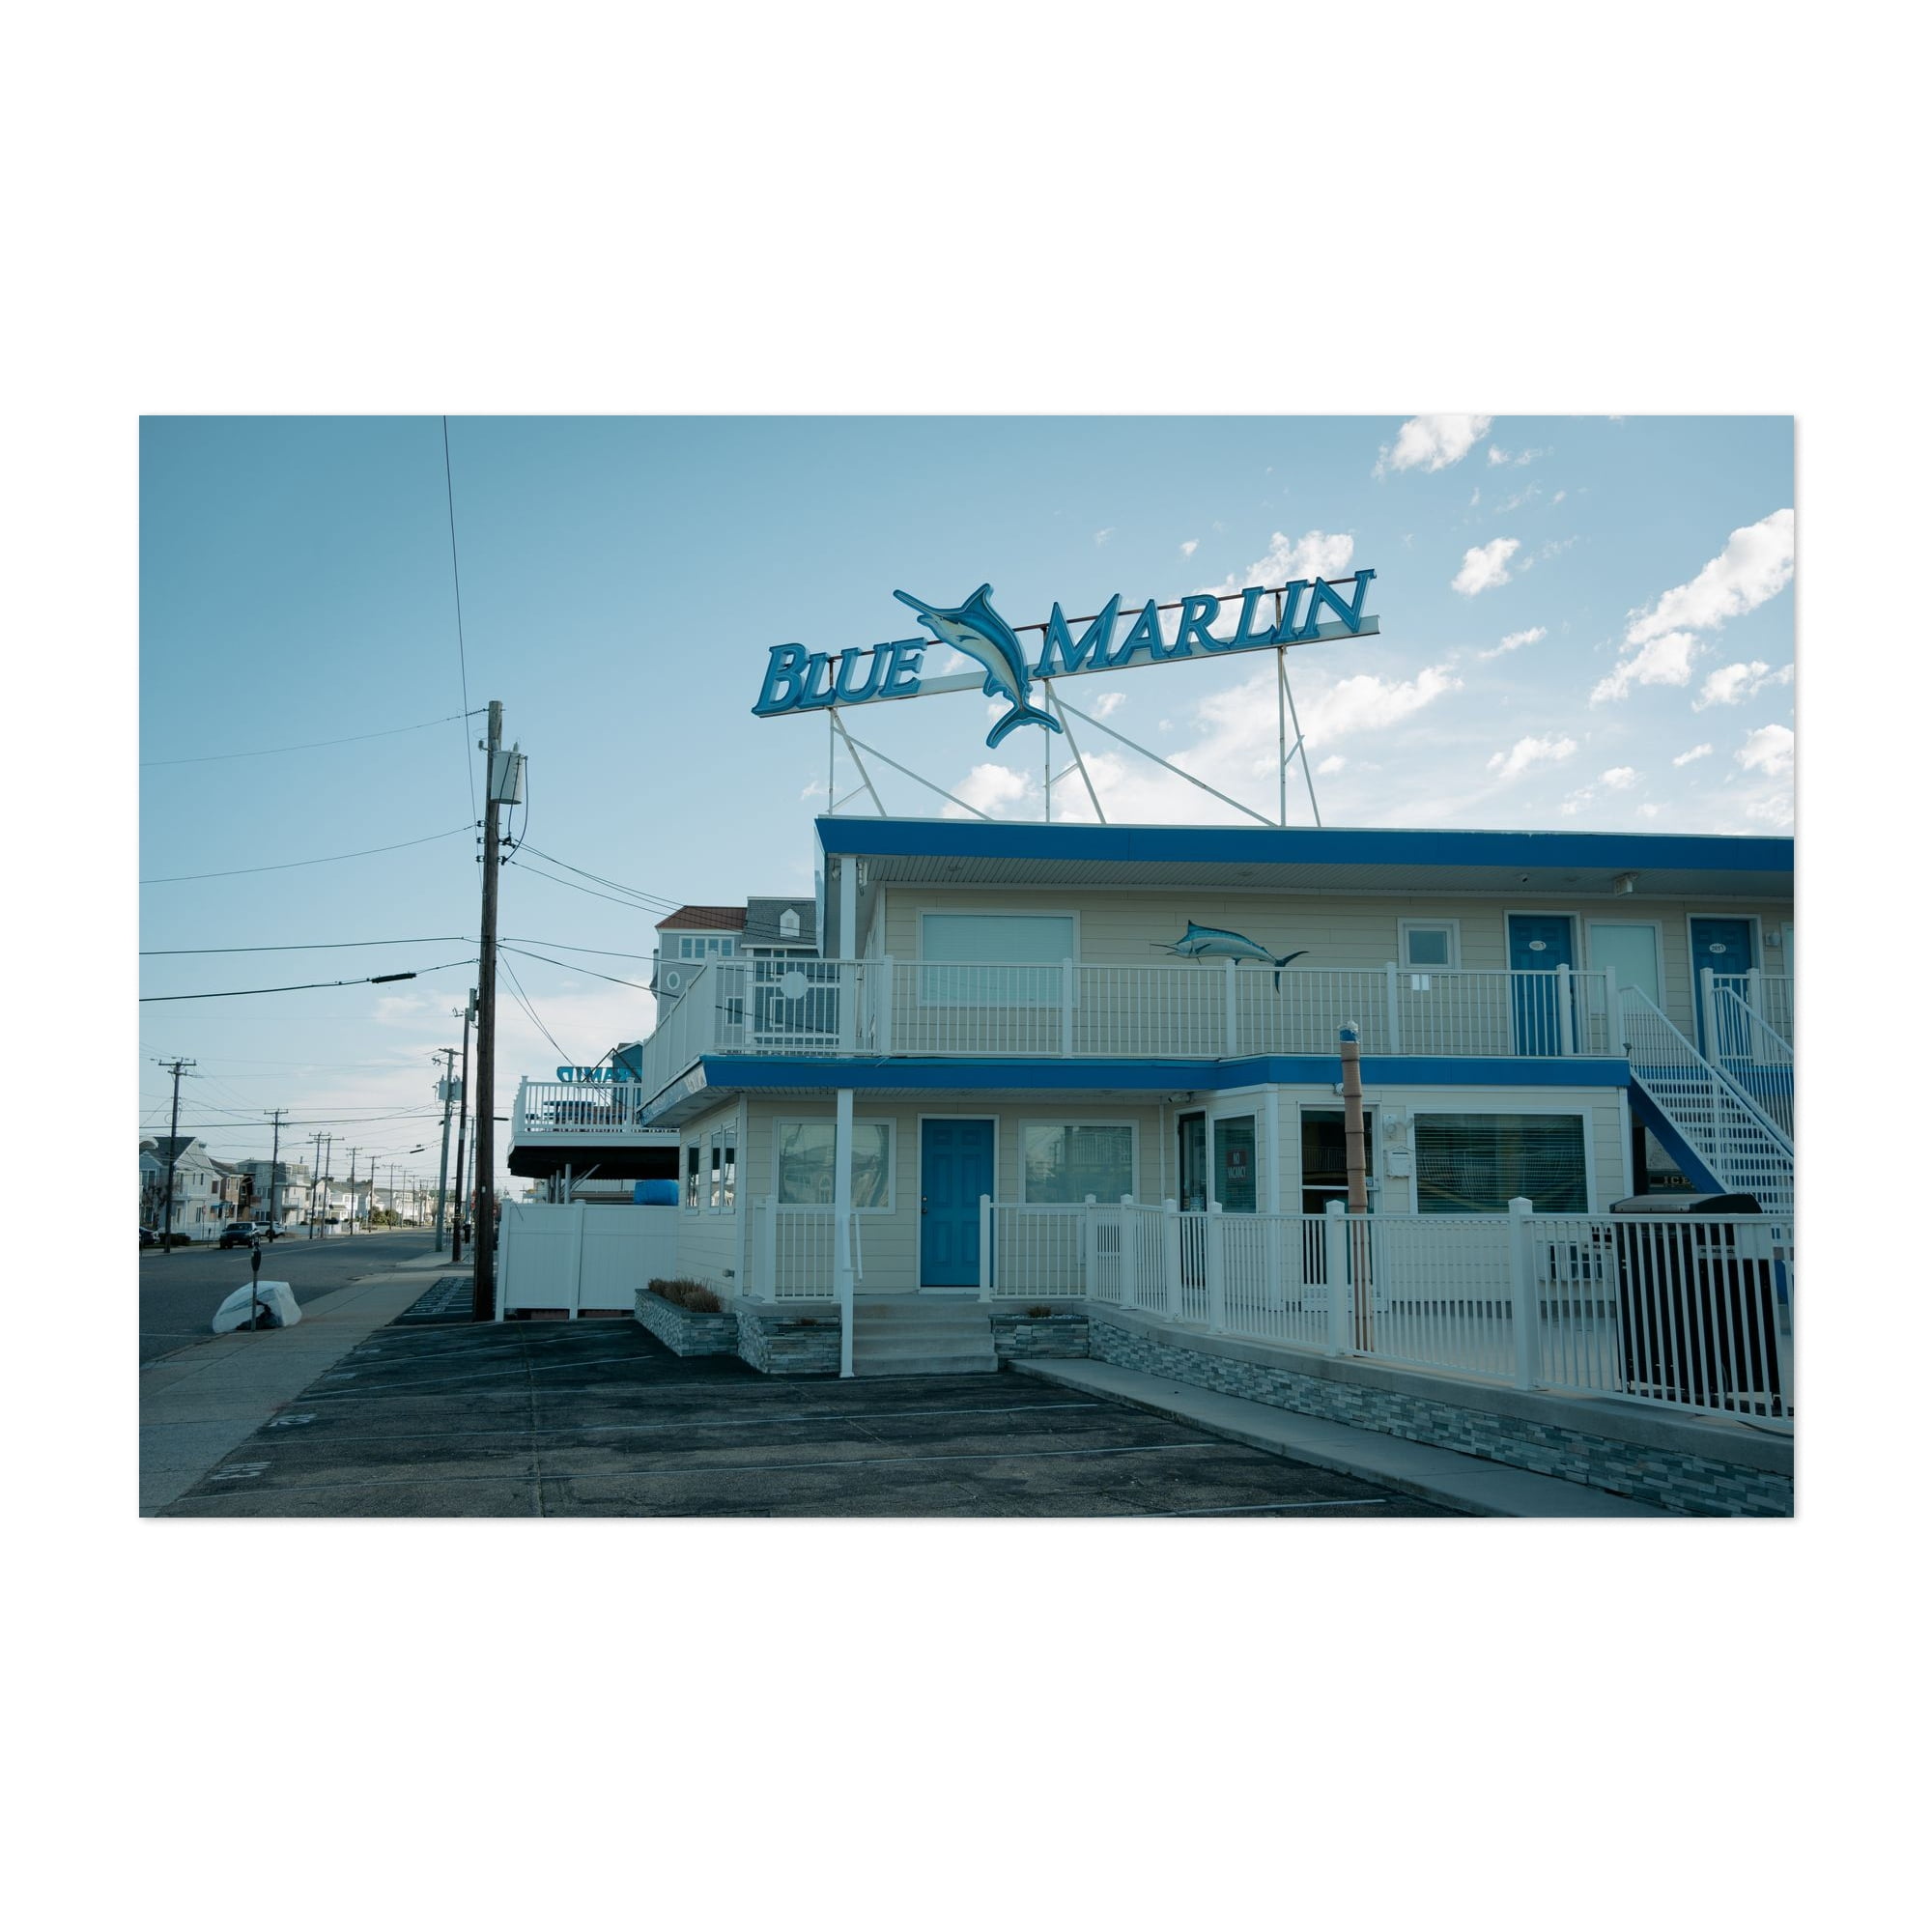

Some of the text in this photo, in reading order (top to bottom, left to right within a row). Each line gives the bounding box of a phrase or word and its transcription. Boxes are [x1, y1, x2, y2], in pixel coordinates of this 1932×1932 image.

[752, 568, 1378, 716] BLUE MARLIN
[1663, 1176, 1691, 1184] ICE
